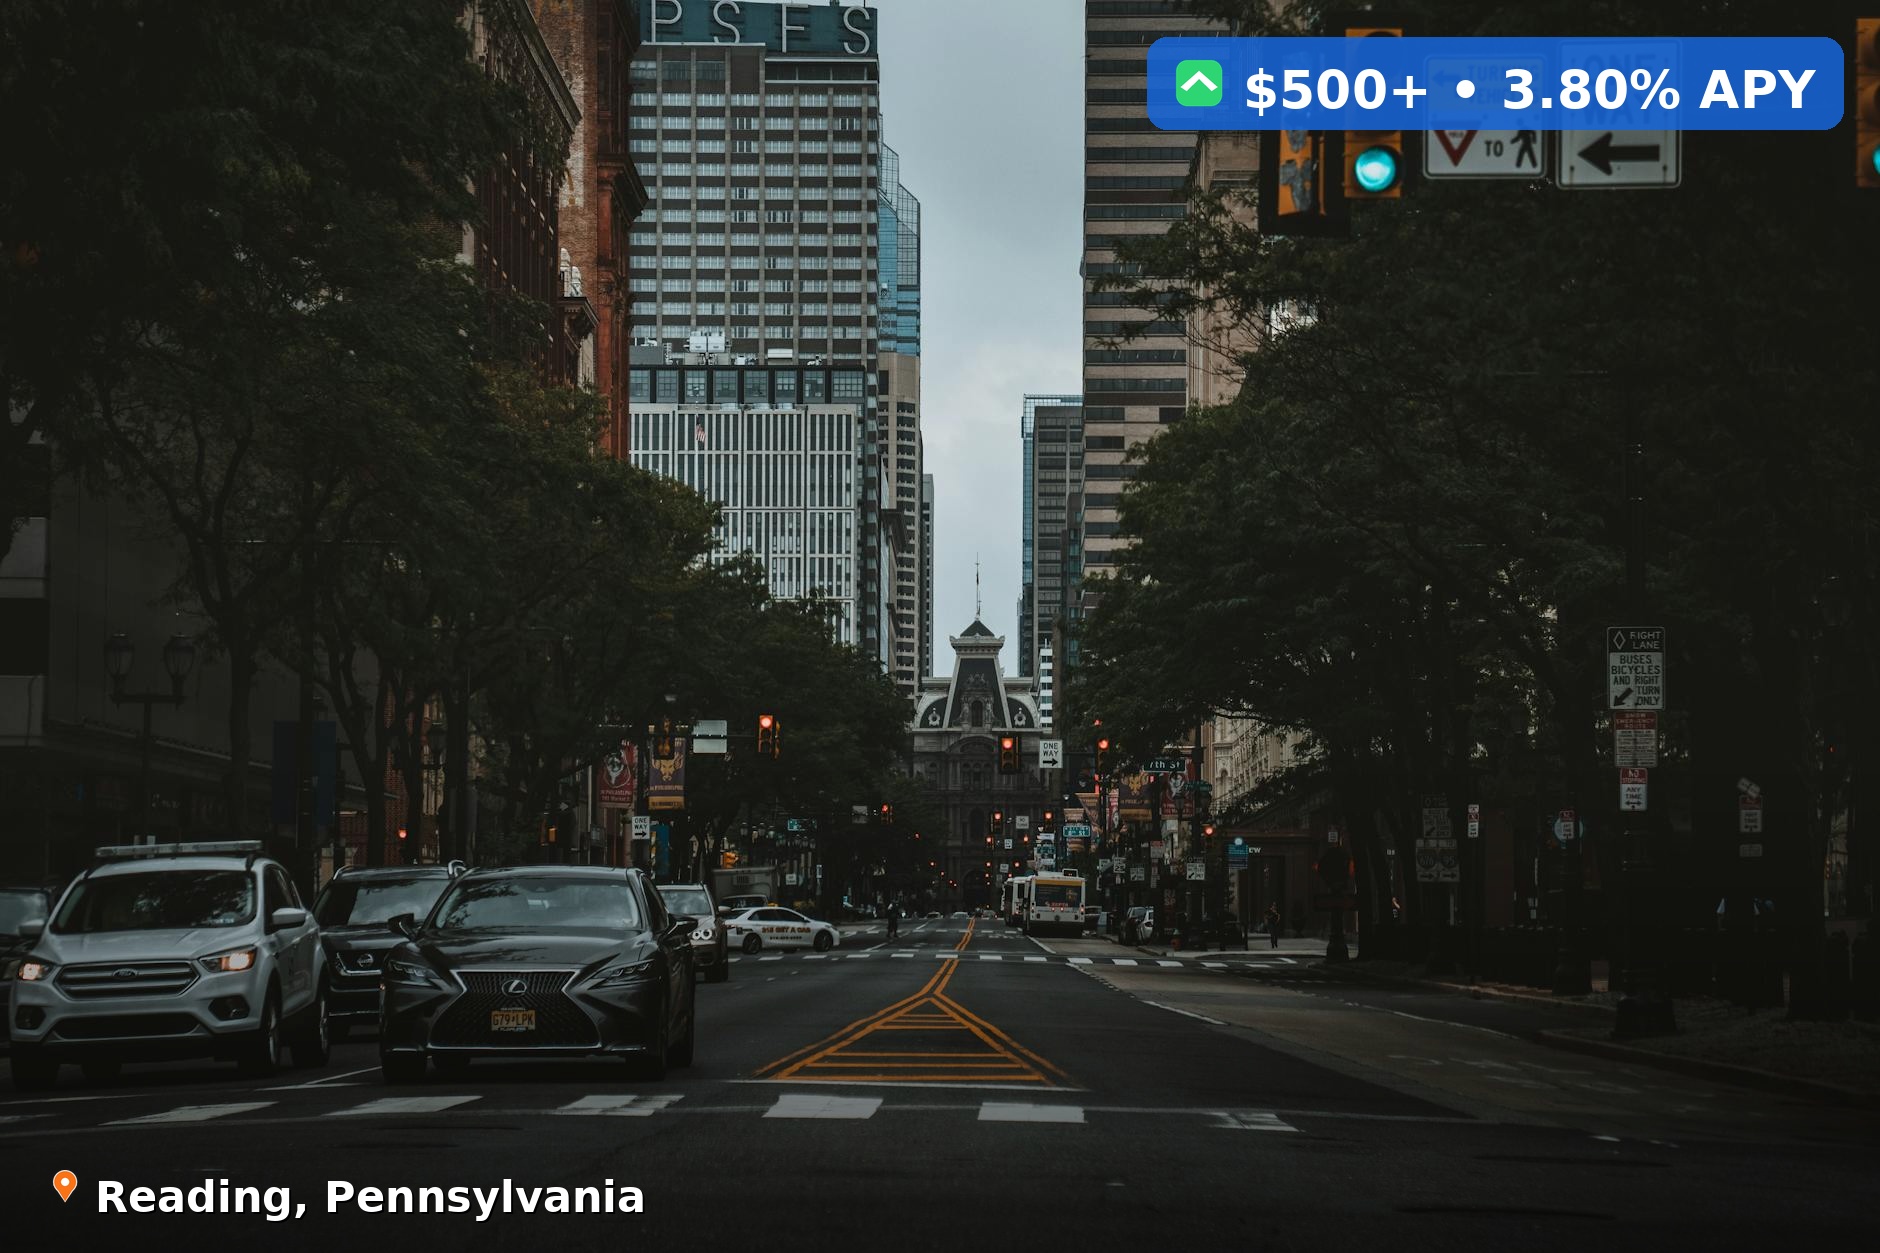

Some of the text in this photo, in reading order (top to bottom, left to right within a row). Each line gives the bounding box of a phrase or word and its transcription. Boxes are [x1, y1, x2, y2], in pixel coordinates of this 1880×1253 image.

[651, 0, 871, 54] PSFS
[1484, 140, 1504, 157] TO
[1632, 640, 1661, 649] LANE
[1620, 654, 1652, 664] BUSES
[1611, 665, 1661, 675] BICYCLES
[1613, 675, 1659, 685] AND RIGHT
[1637, 685, 1660, 695] TURN
[1637, 696, 1660, 706] ONLY
[1043, 742, 1059, 750] ONE
